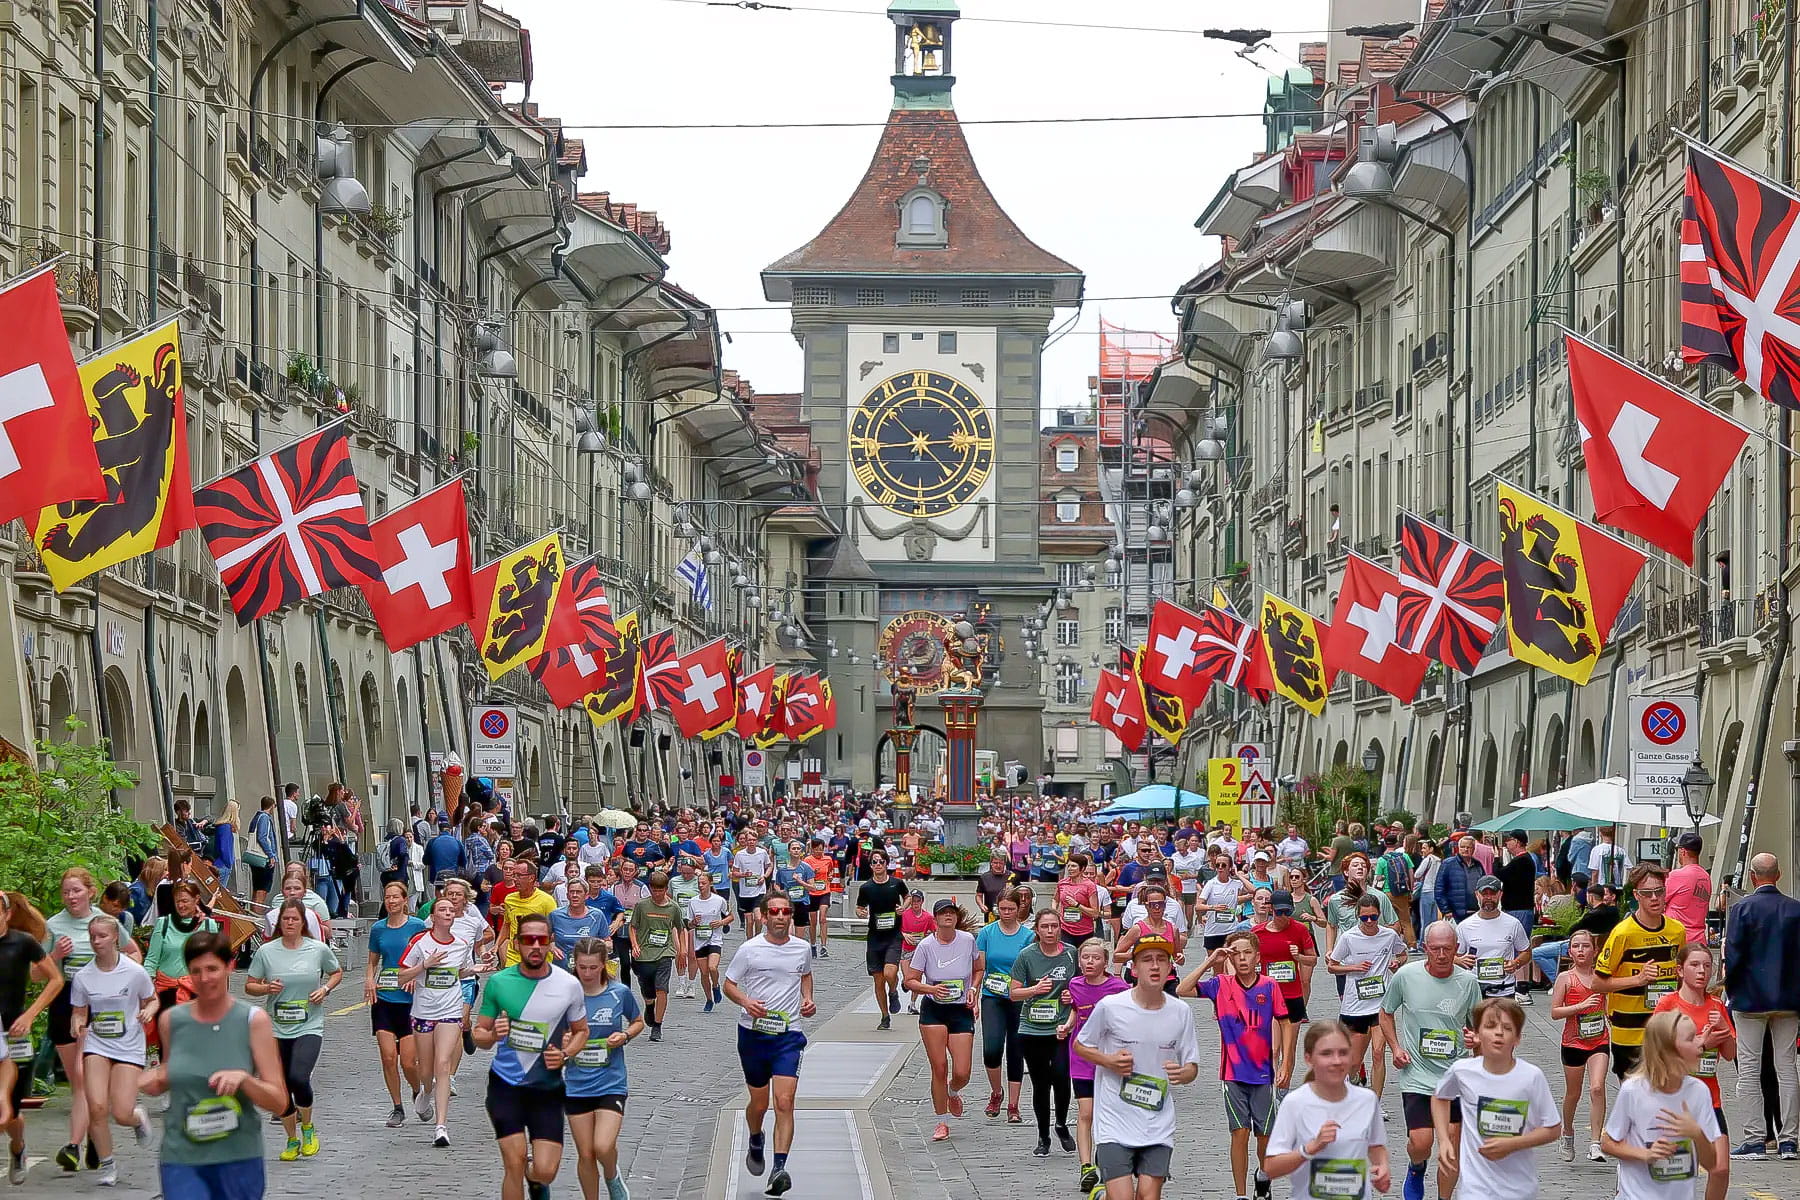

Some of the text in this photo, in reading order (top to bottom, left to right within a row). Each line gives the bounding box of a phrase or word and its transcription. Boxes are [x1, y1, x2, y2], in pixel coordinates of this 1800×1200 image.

[912, 372, 928, 387] XII
[977, 437, 992, 451] III
[1637, 752, 1690, 761] Ganze Gasse
[1222, 763, 1236, 786] 2
[1646, 775, 1681, 784] 18.05.24
[1651, 787, 1675, 795] 12.00
[1429, 1040, 1448, 1048] Peter
[1135, 1086, 1153, 1096] Fred
